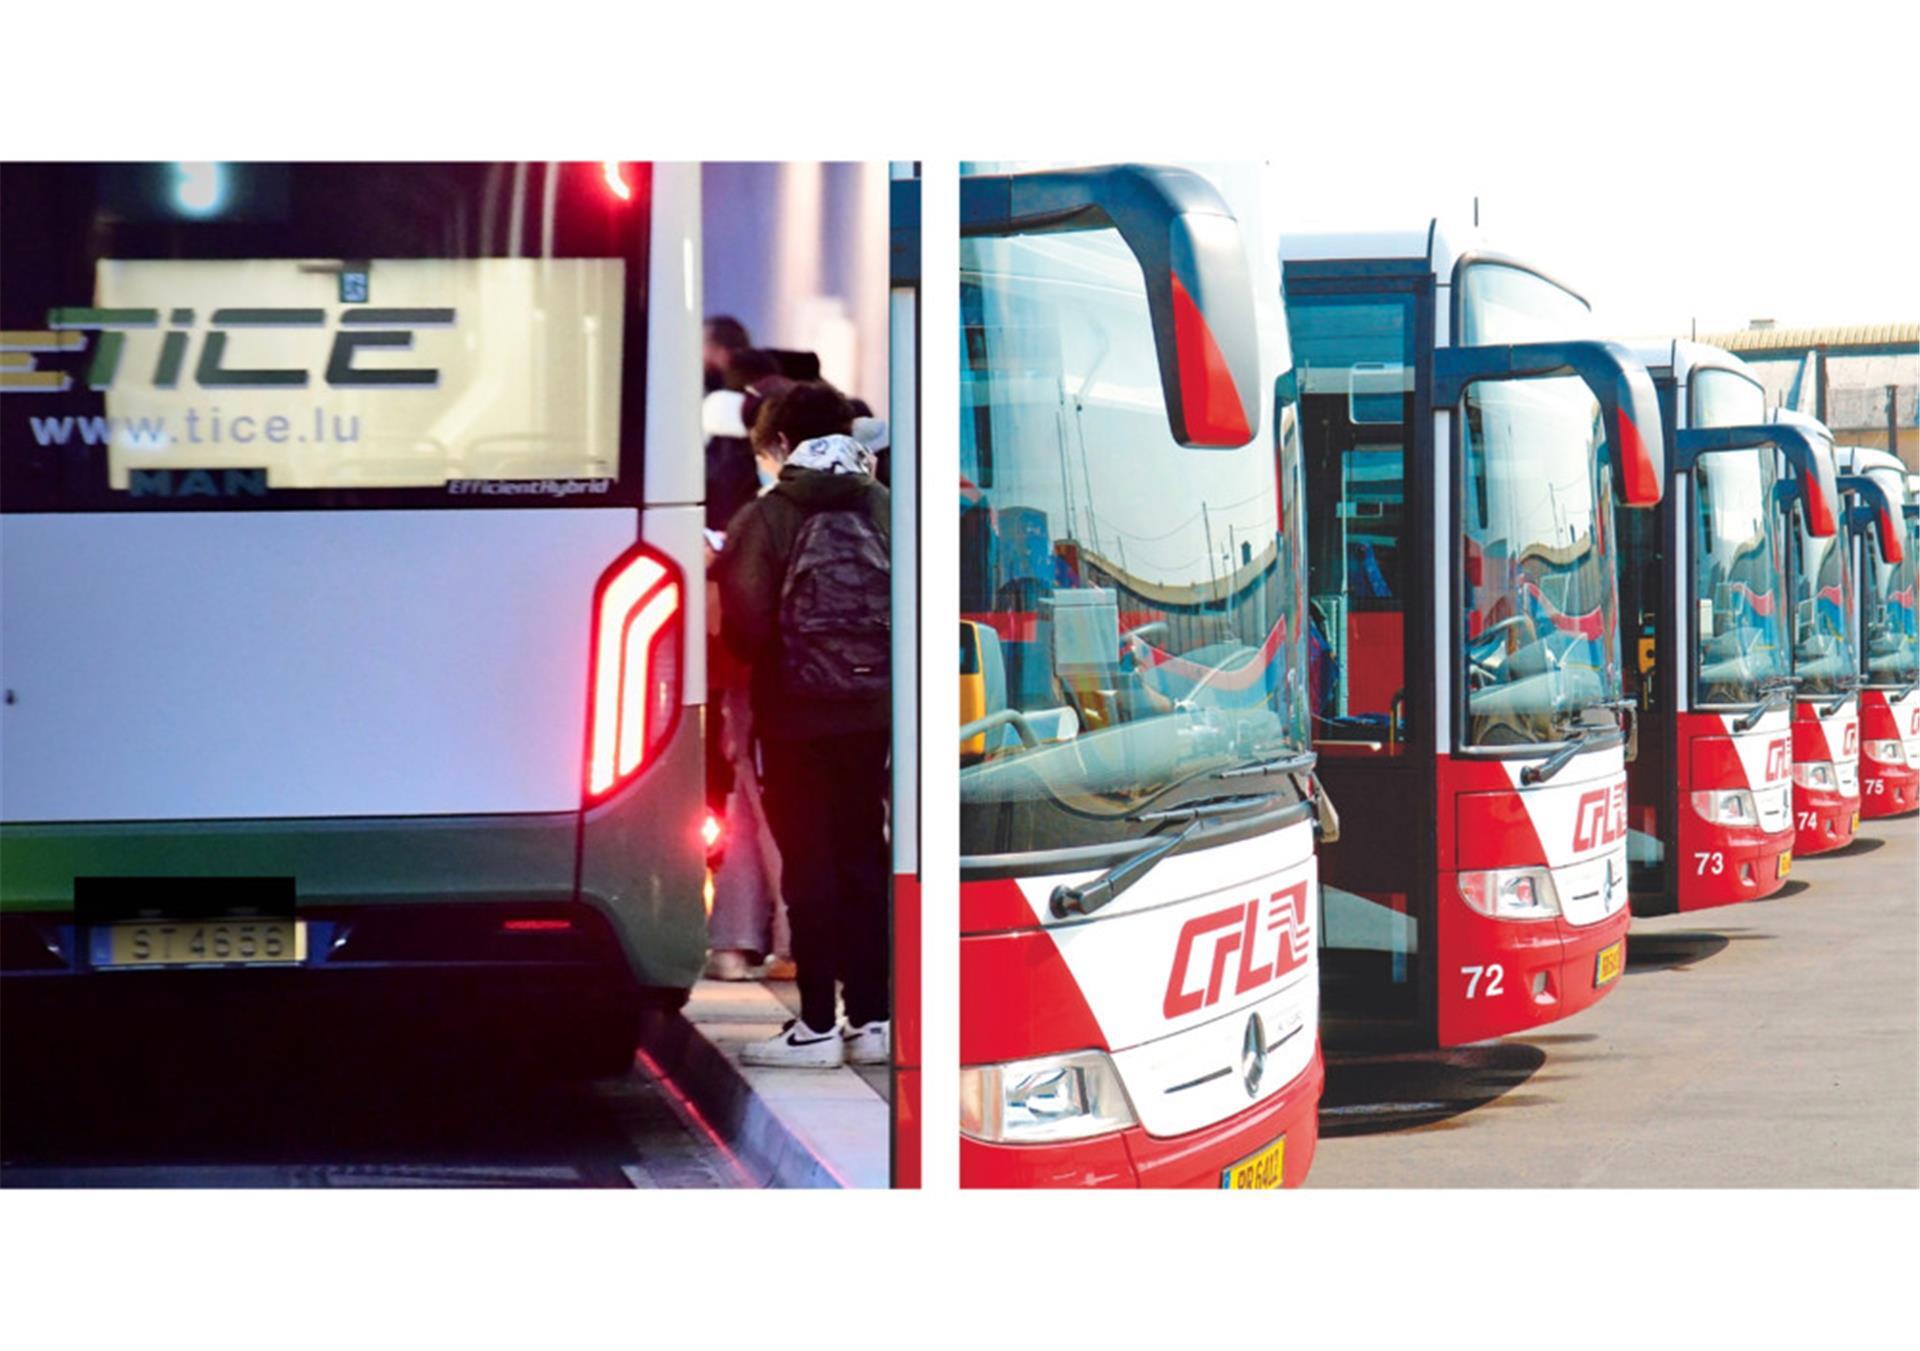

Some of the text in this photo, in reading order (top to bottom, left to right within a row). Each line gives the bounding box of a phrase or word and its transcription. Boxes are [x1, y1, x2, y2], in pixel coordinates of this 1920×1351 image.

[29, 407, 362, 447] www.tice.lu
[129, 469, 268, 497] MAN
[1865, 779, 1885, 796] 75
[1797, 811, 1818, 832] 74
[1694, 851, 1724, 876] 73
[1163, 898, 1273, 1020] CFL
[1461, 963, 1505, 999] 72
